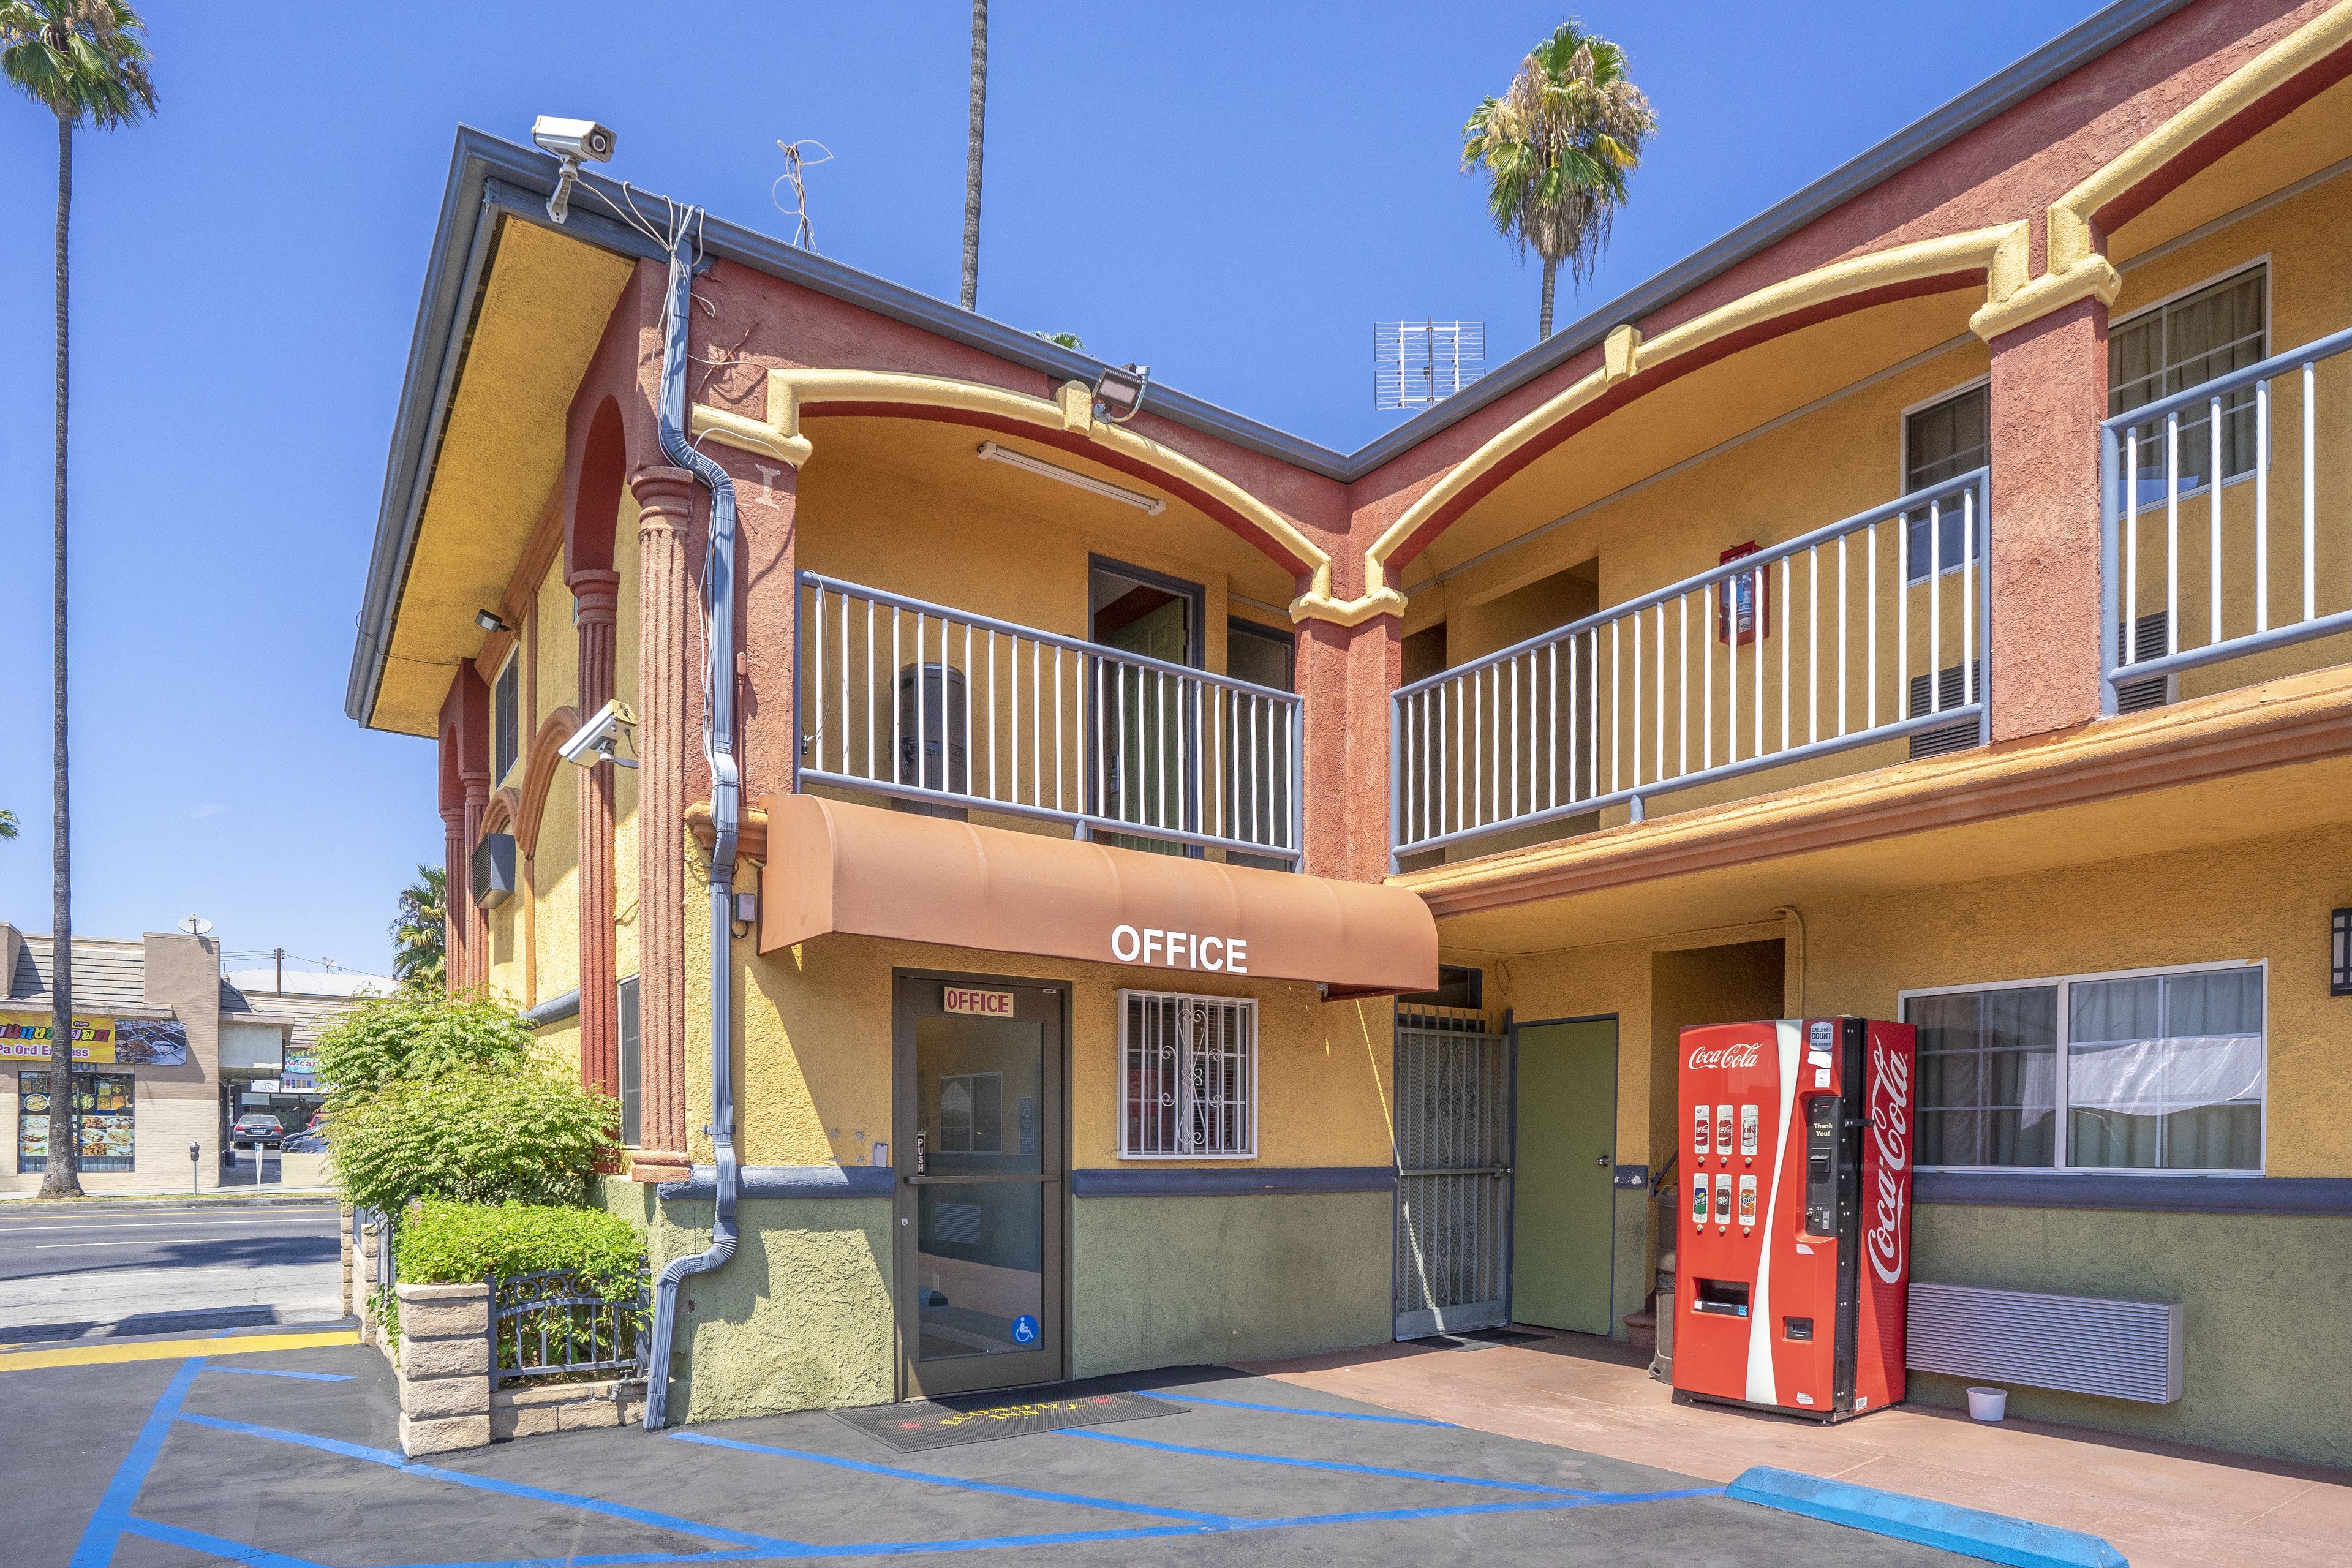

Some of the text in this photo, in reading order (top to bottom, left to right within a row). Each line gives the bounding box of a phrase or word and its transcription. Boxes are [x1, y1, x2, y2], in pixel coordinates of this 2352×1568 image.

[1111, 924, 1248, 974] OFFICE
[947, 990, 1009, 1013] OFFICE
[15, 1044, 37, 1055] Ord
[42, 1045, 88, 1057] Exess
[1689, 1041, 1765, 1070] Coca-Cola
[1868, 1033, 1908, 1284] Coca-Cola
